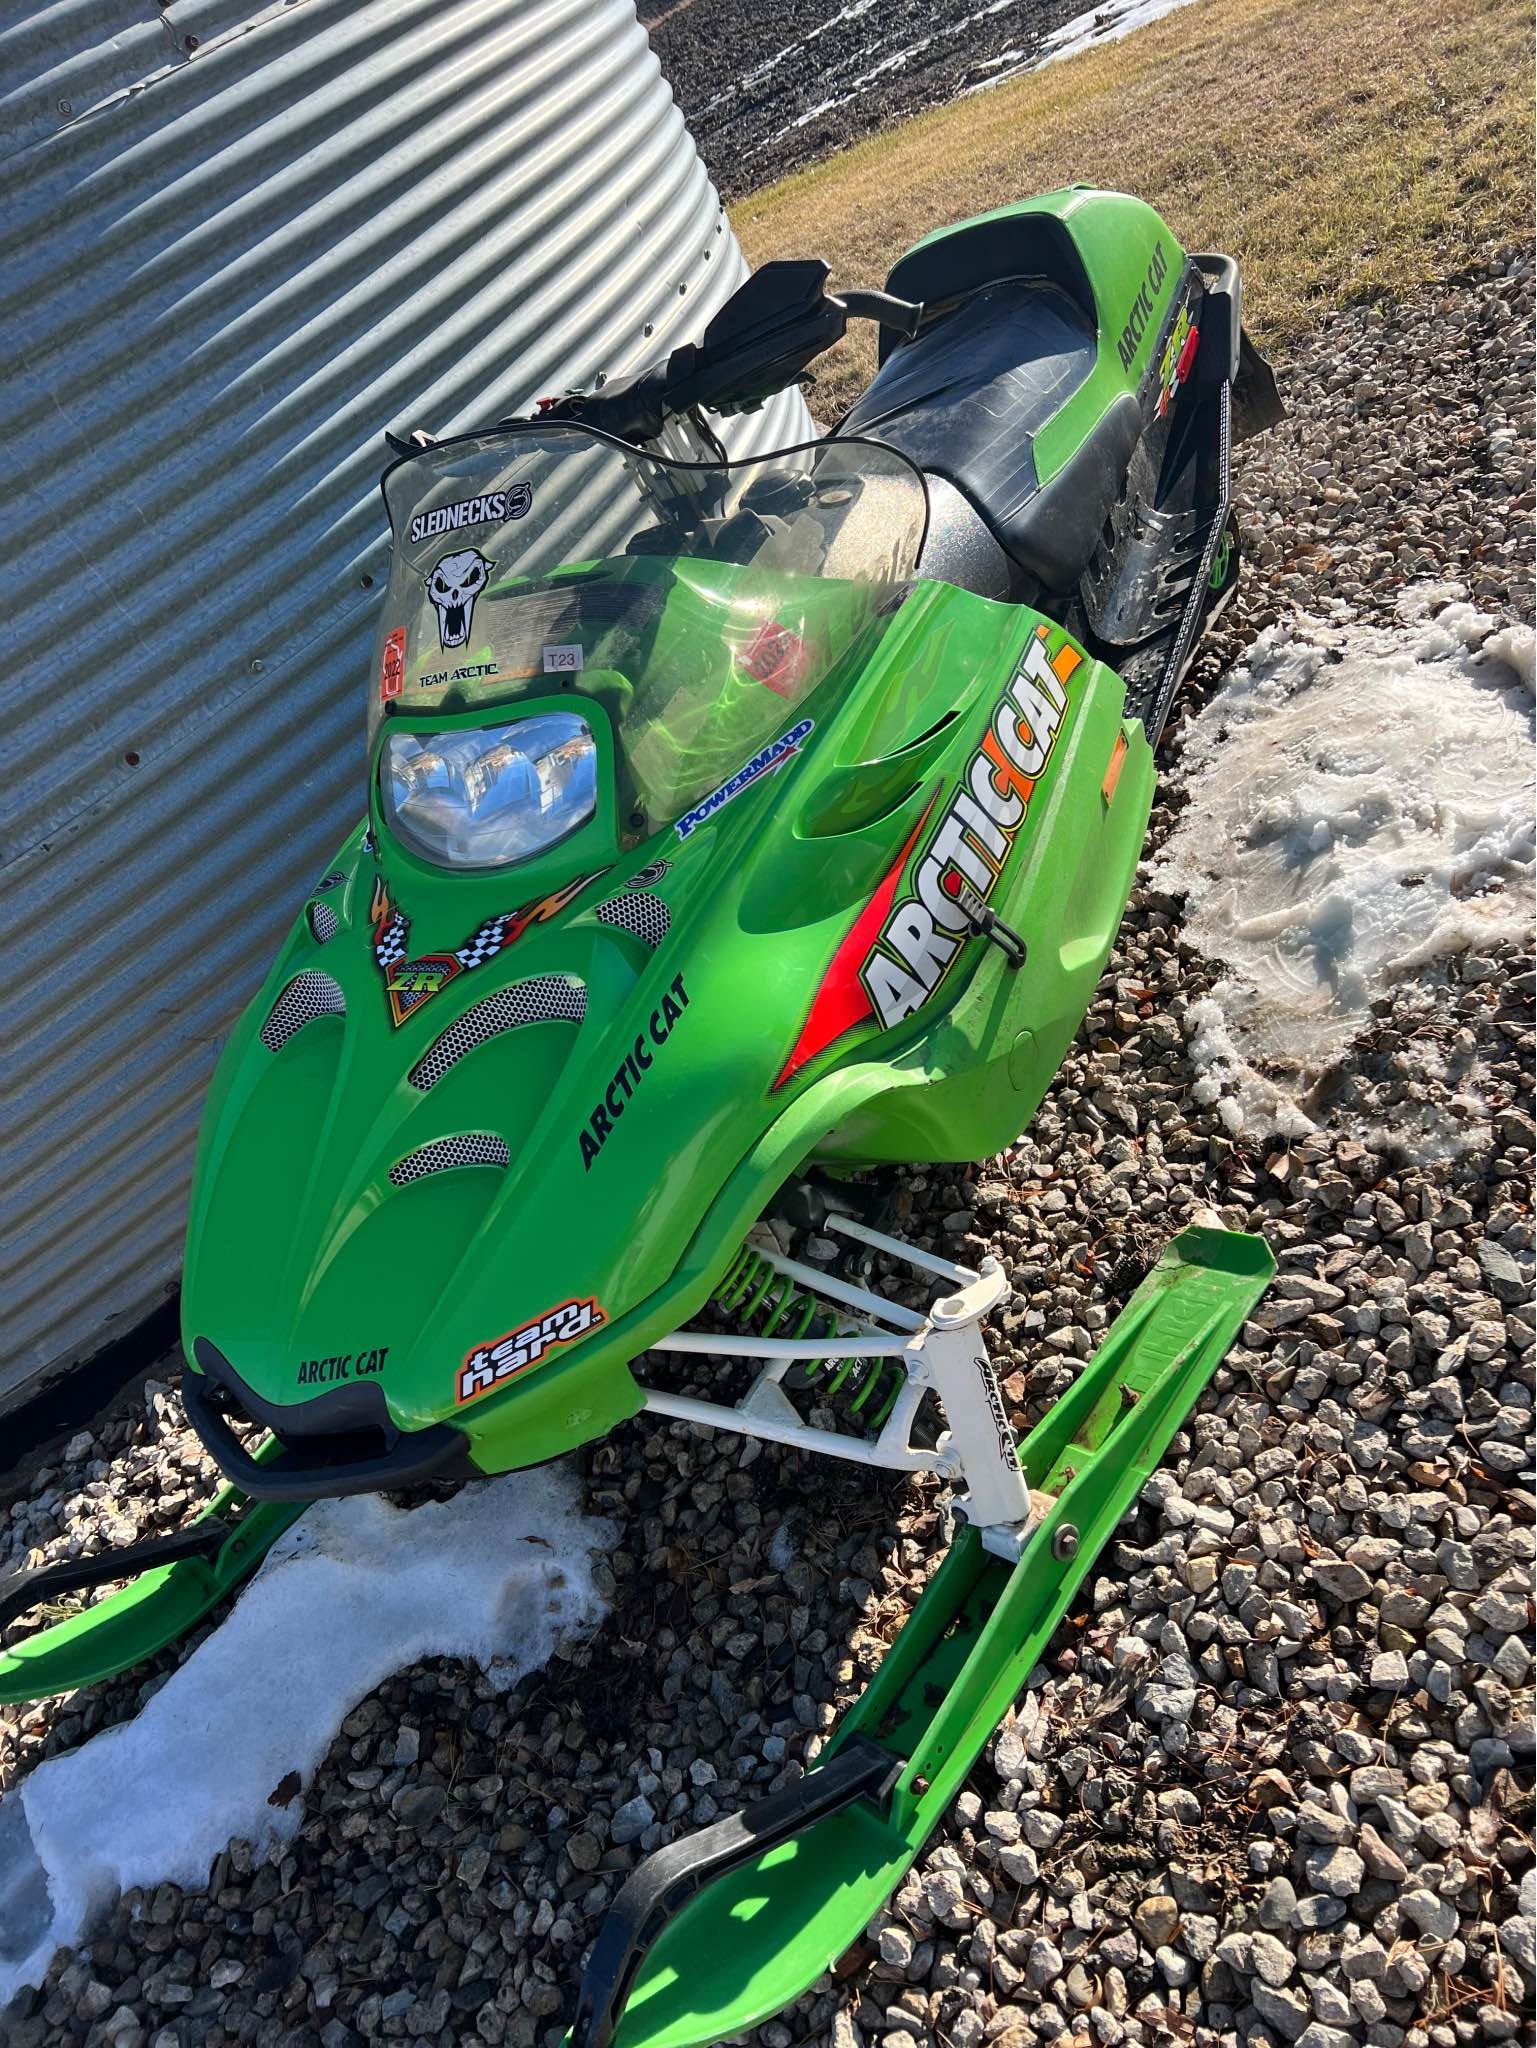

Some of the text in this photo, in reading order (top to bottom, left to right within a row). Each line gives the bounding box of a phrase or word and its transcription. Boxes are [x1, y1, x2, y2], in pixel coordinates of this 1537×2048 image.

[1116, 240, 1168, 374] ARCTIC CAT
[411, 492, 506, 542] SLEDNECKS
[419, 663, 498, 687] TEAM ARCTIC
[548, 653, 575, 667] T23
[864, 634, 1068, 1031] ARCTIC CAT
[385, 972, 444, 992] ZR
[578, 971, 690, 1174] ARCTIC CAT
[469, 1303, 579, 1372] team
[297, 1347, 389, 1385] ARCTIC CAT
